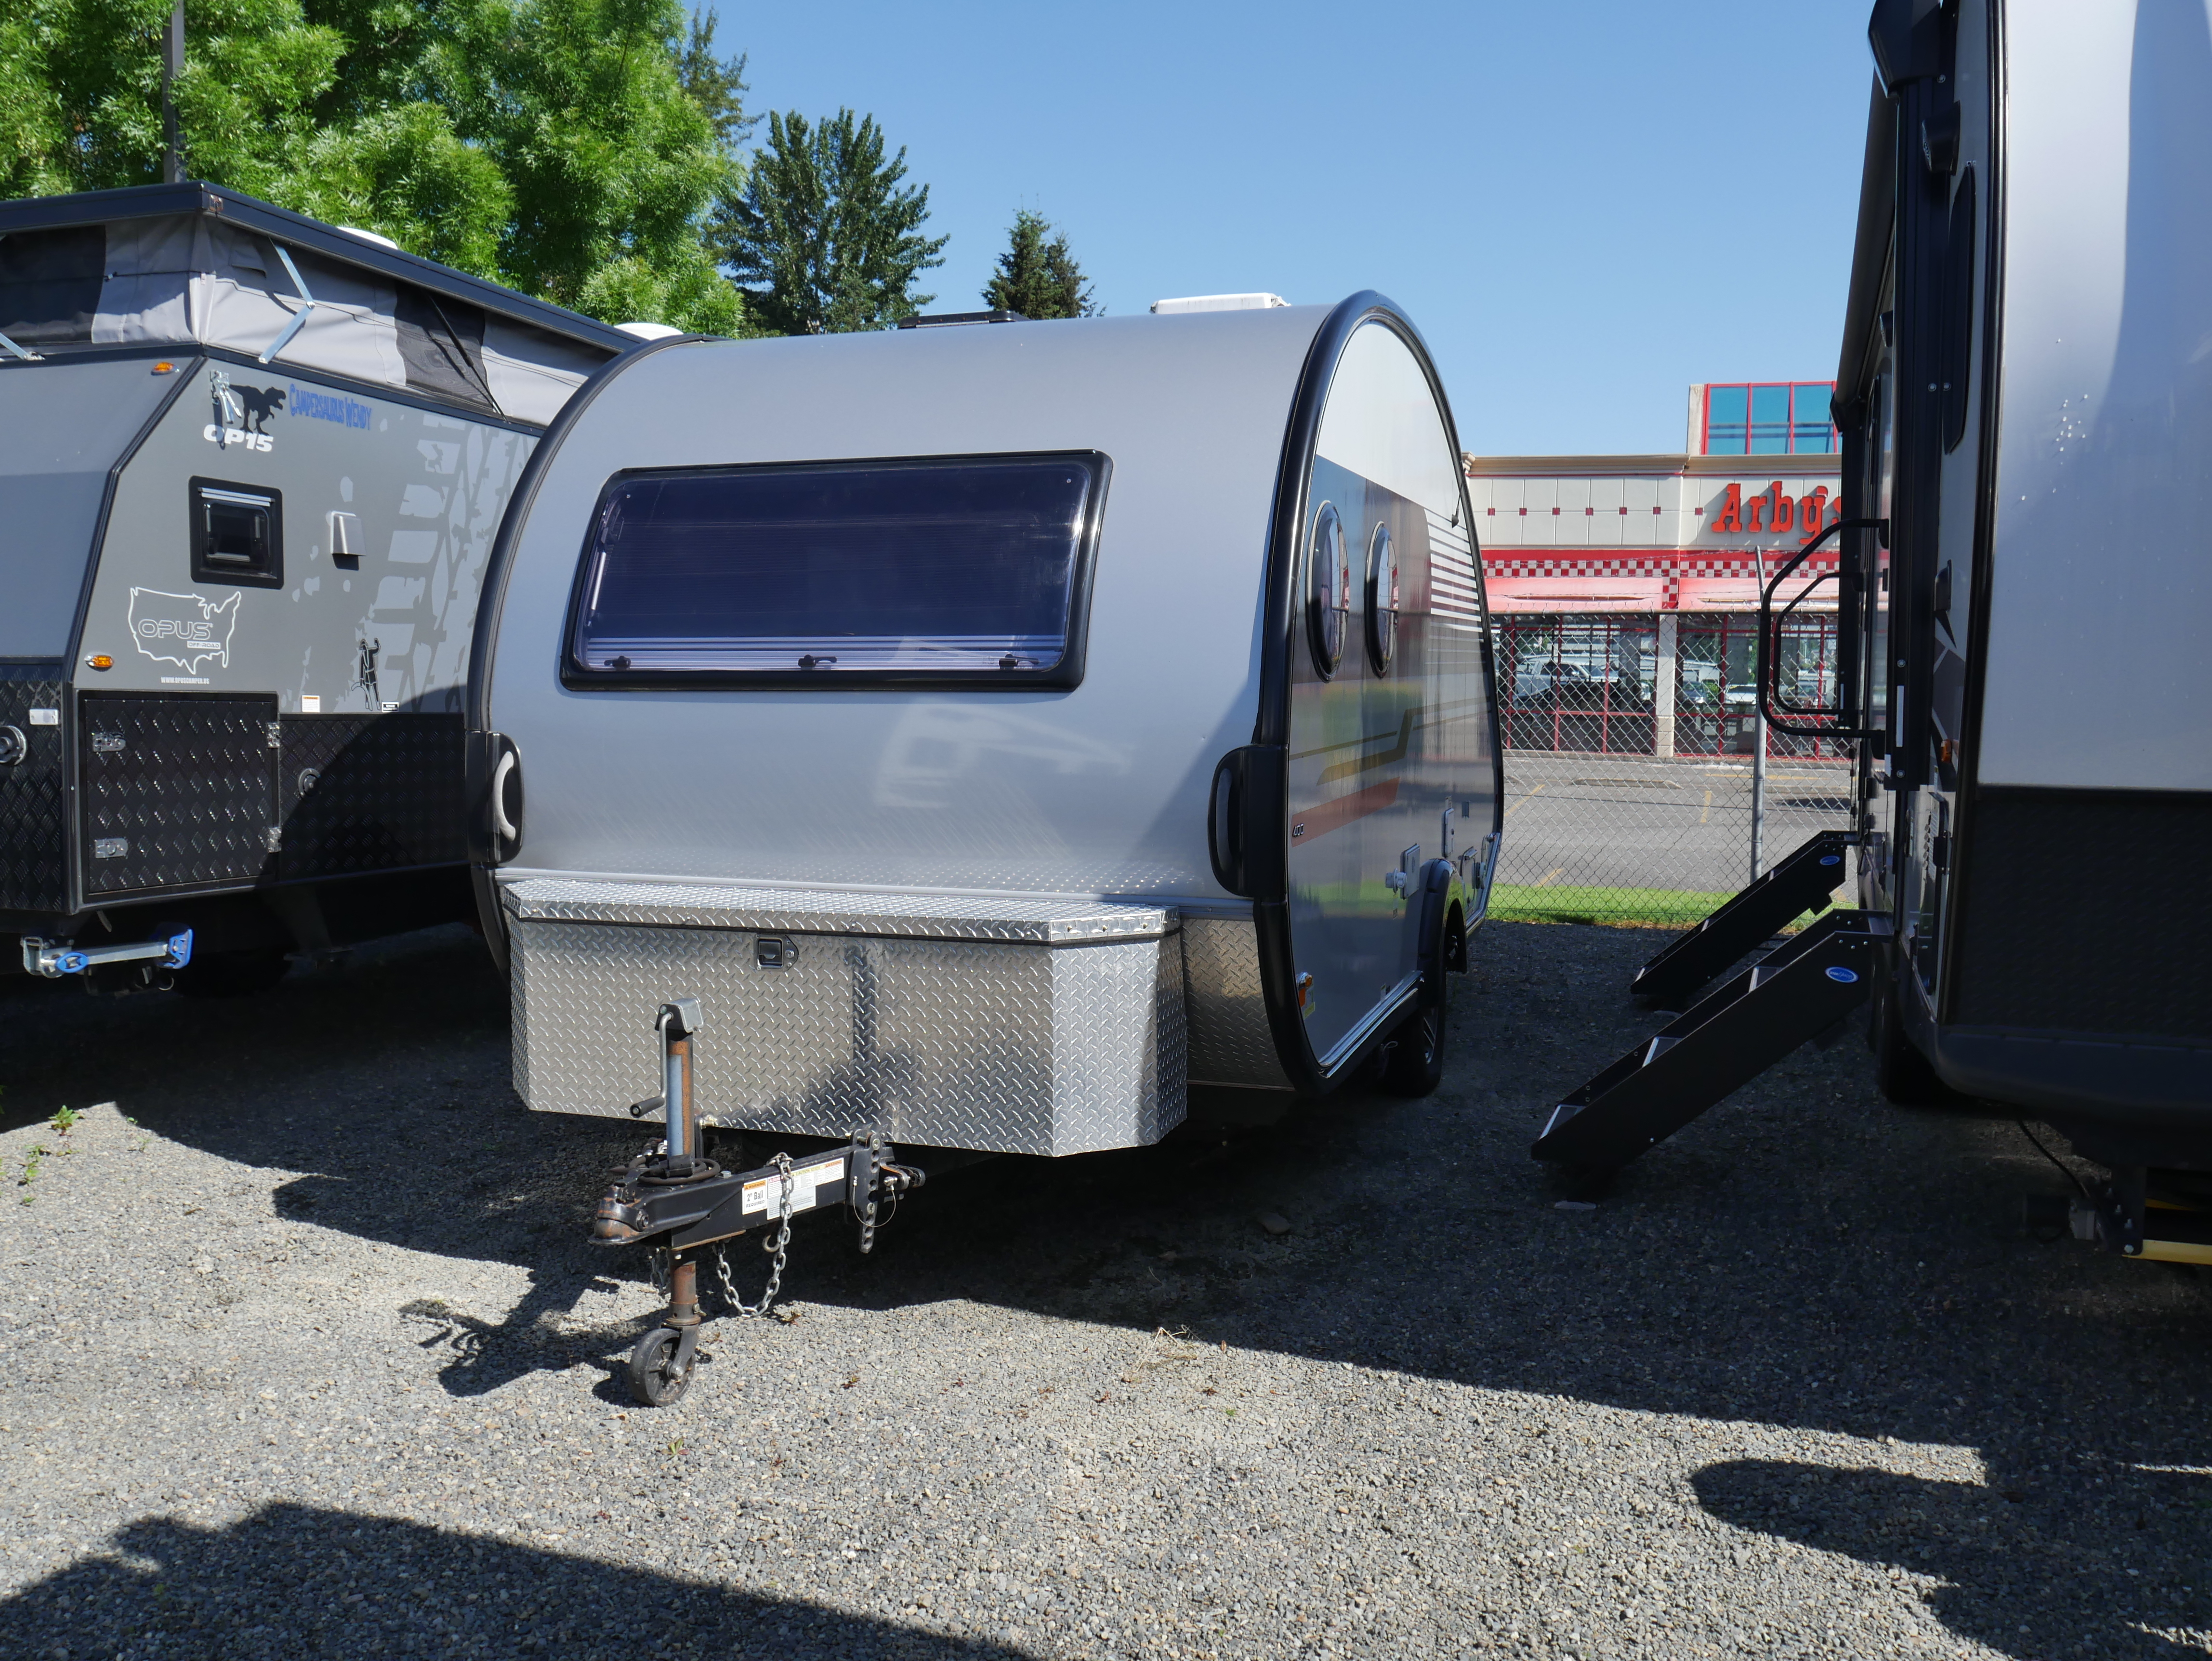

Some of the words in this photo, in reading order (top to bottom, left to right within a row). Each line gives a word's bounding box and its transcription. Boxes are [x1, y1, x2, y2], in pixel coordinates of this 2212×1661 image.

[204, 424, 274, 452] OP15
[138, 619, 210, 640] OPUS
[746, 1200, 765, 1208] REQUIRED
[747, 1193, 752, 1202] 2"
[754, 1190, 763, 1200] Ball
